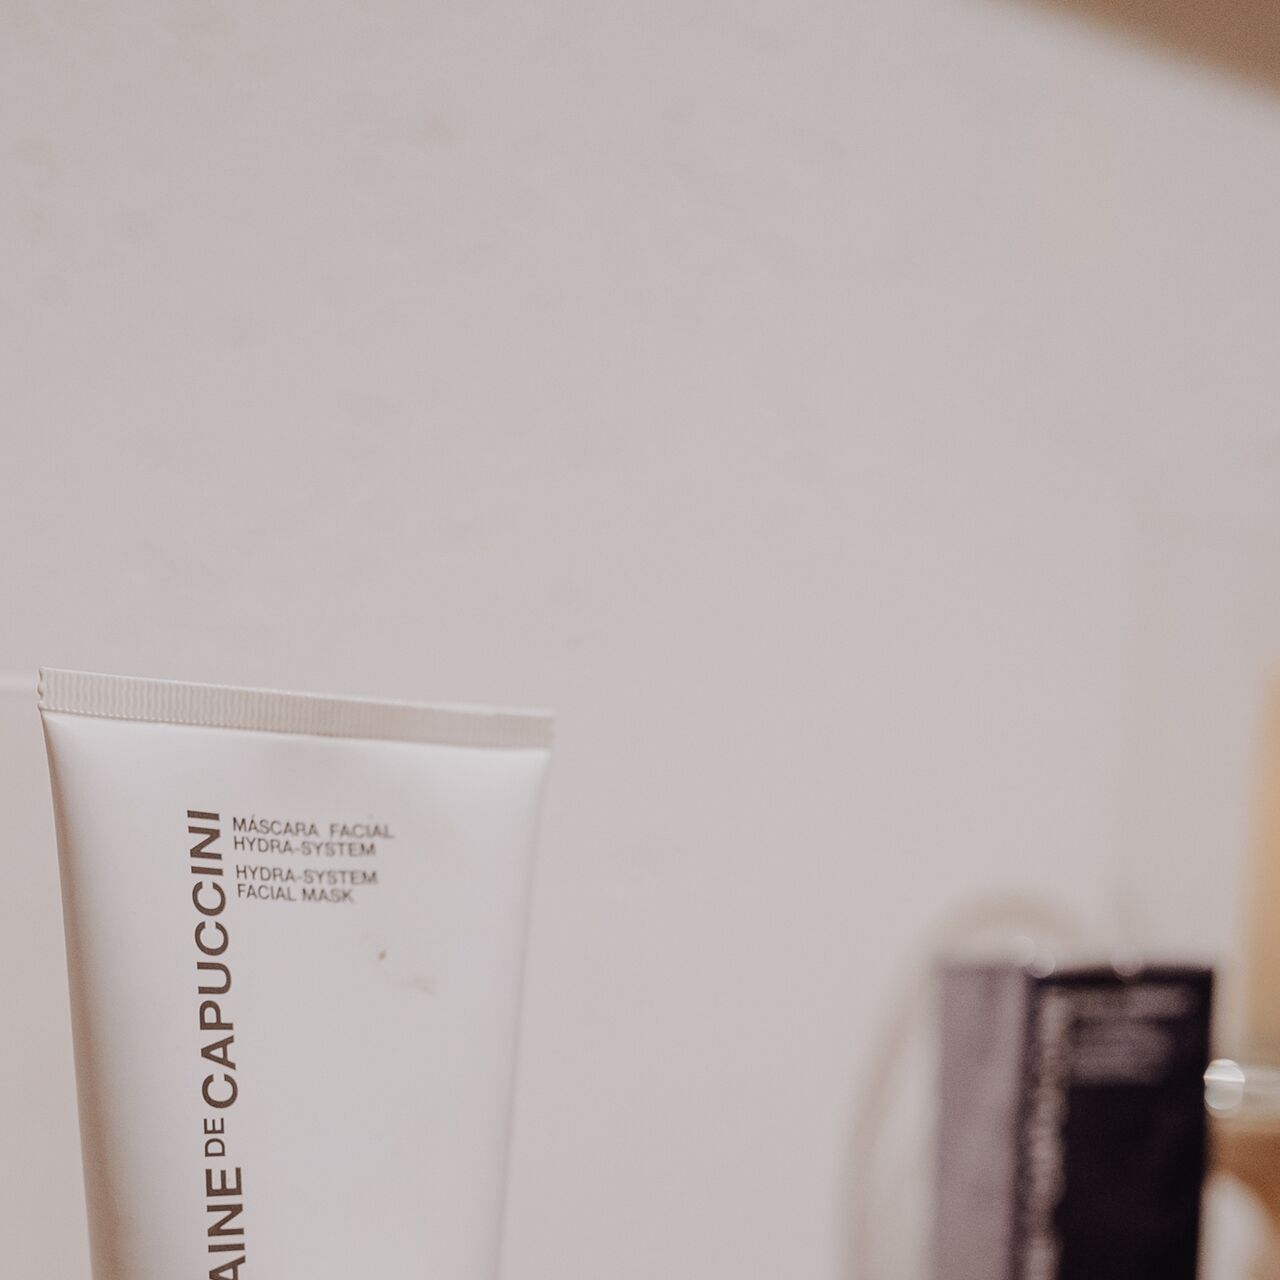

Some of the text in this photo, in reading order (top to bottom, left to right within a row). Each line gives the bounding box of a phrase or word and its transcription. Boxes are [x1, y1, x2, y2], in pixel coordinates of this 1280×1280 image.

[232, 814, 396, 840] MÁSCARA FACIAL
[233, 836, 377, 857] HYDRA-SYSTEM
[236, 865, 379, 885] HYDRA-SYSTEM
[237, 884, 355, 904] FACIAL MASK
[186, 809, 240, 1110] CAPUCCINI
[203, 1117, 227, 1158] DE
